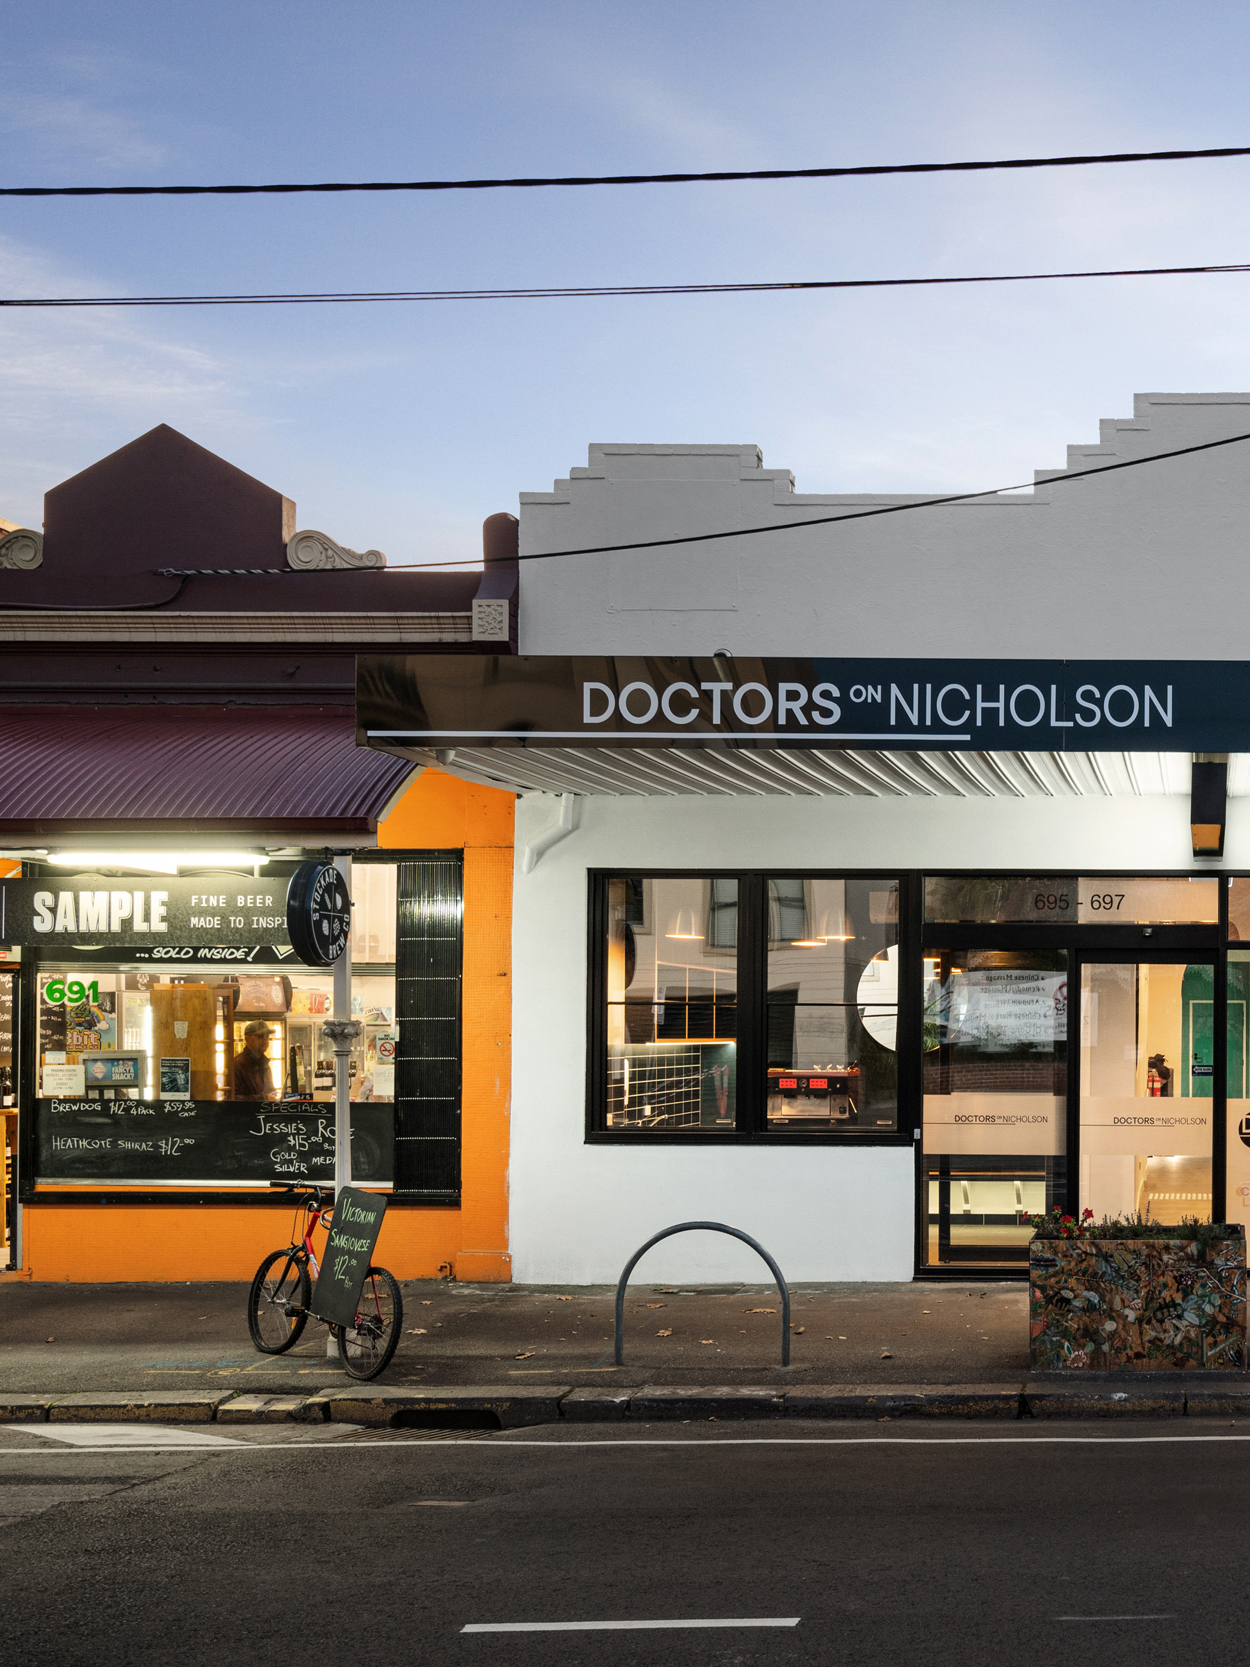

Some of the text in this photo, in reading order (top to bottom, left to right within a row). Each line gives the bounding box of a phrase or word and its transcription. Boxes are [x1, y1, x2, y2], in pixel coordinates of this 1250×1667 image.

[583, 681, 1173, 728] DOCTORS ON NICHOLSON
[191, 895, 273, 907] FINE BEER
[313, 868, 337, 920] STOCKADE
[1034, 893, 1070, 911] 695
[1090, 893, 1125, 911] 697
[33, 891, 168, 933] SAMPLE
[190, 917, 288, 928] MADE TO INSPI
[329, 914, 350, 959] BREW CO
[198, 945, 260, 961] INSIDE!
[44, 980, 99, 1005] 691
[51, 1099, 101, 1112] BREWDOG
[260, 1102, 327, 1114] SPECIALS
[954, 1115, 996, 1123] DOCTORS
[1003, 1115, 1048, 1124] NICHOLSON
[1113, 1117, 1155, 1125] DOCTORS
[1161, 1117, 1207, 1126] NICHOLSON
[52, 1135, 113, 1150] HEATHCOTE
[118, 1139, 154, 1151] SHIRAZ
[270, 1148, 297, 1161] GOLD
[274, 1160, 308, 1174] SILVER
[341, 1197, 377, 1224] VICTORIAN
[330, 1228, 371, 1252] SANGIOVESE
